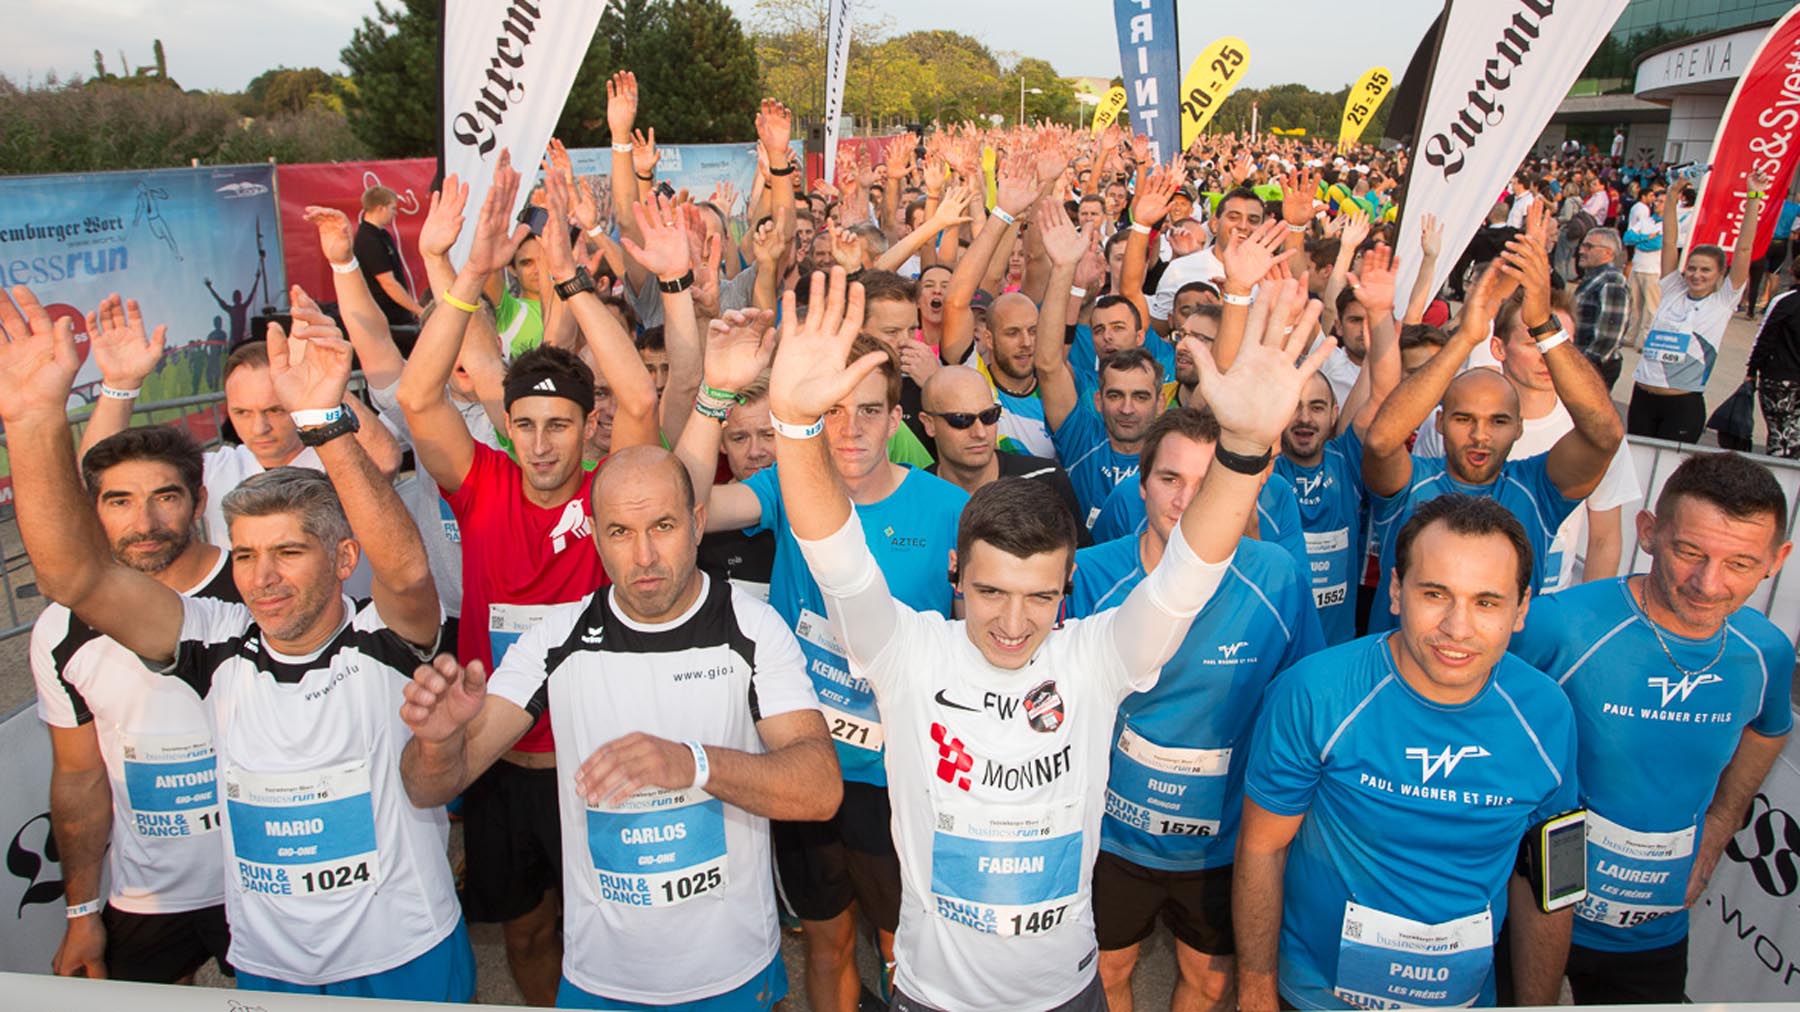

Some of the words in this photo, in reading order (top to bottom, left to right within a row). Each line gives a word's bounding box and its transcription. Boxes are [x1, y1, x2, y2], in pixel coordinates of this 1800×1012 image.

[1663, 41, 1733, 80] ARENA
[1181, 88, 1212, 123] 20
[1211, 45, 1244, 80] 25
[1110, 92, 1124, 106] 45
[1347, 103, 1368, 126] 25
[1366, 72, 1388, 95] 35
[891, 537, 926, 548] AZTEC
[1317, 589, 1344, 606] 1552
[984, 692, 1019, 720] FW
[1603, 703, 1635, 717] PAUL
[1640, 708, 1690, 722] WAGNER
[1694, 712, 1708, 723] ET
[1711, 712, 1732, 723] FILS
[831, 718, 869, 744] 271
[982, 744, 1071, 791] MONNET
[1147, 778, 1187, 796] RUDY
[1360, 773, 1394, 792] PAUL
[1401, 784, 1457, 802] WAGNER
[1463, 792, 1479, 805] ET
[1485, 794, 1514, 806] FILS
[1105, 802, 1151, 831] DANCE
[1107, 792, 1138, 817] RUN
[1139, 810, 1151, 821] &
[136, 813, 171, 826] RUN
[174, 813, 188, 825] &
[265, 818, 324, 837] MARIO
[1160, 820, 1212, 837] 1576
[138, 824, 190, 837] DANCE
[621, 823, 687, 844] CARLOS
[239, 862, 272, 882] RUN
[275, 868, 289, 882] &
[978, 856, 1045, 874] FABIAN
[1596, 860, 1670, 884] LAURENT
[241, 876, 292, 895] DANCE
[302, 862, 370, 892] 1024
[599, 873, 633, 892] RUN
[636, 878, 649, 892] &
[661, 867, 722, 902] 1025
[602, 888, 652, 906] DANCE
[936, 897, 979, 919] RUN
[982, 908, 997, 922] &
[937, 906, 997, 935] DANCE
[1010, 904, 1068, 936] 1467
[1389, 962, 1450, 981] PAULO
[1387, 984, 1407, 996] LES
